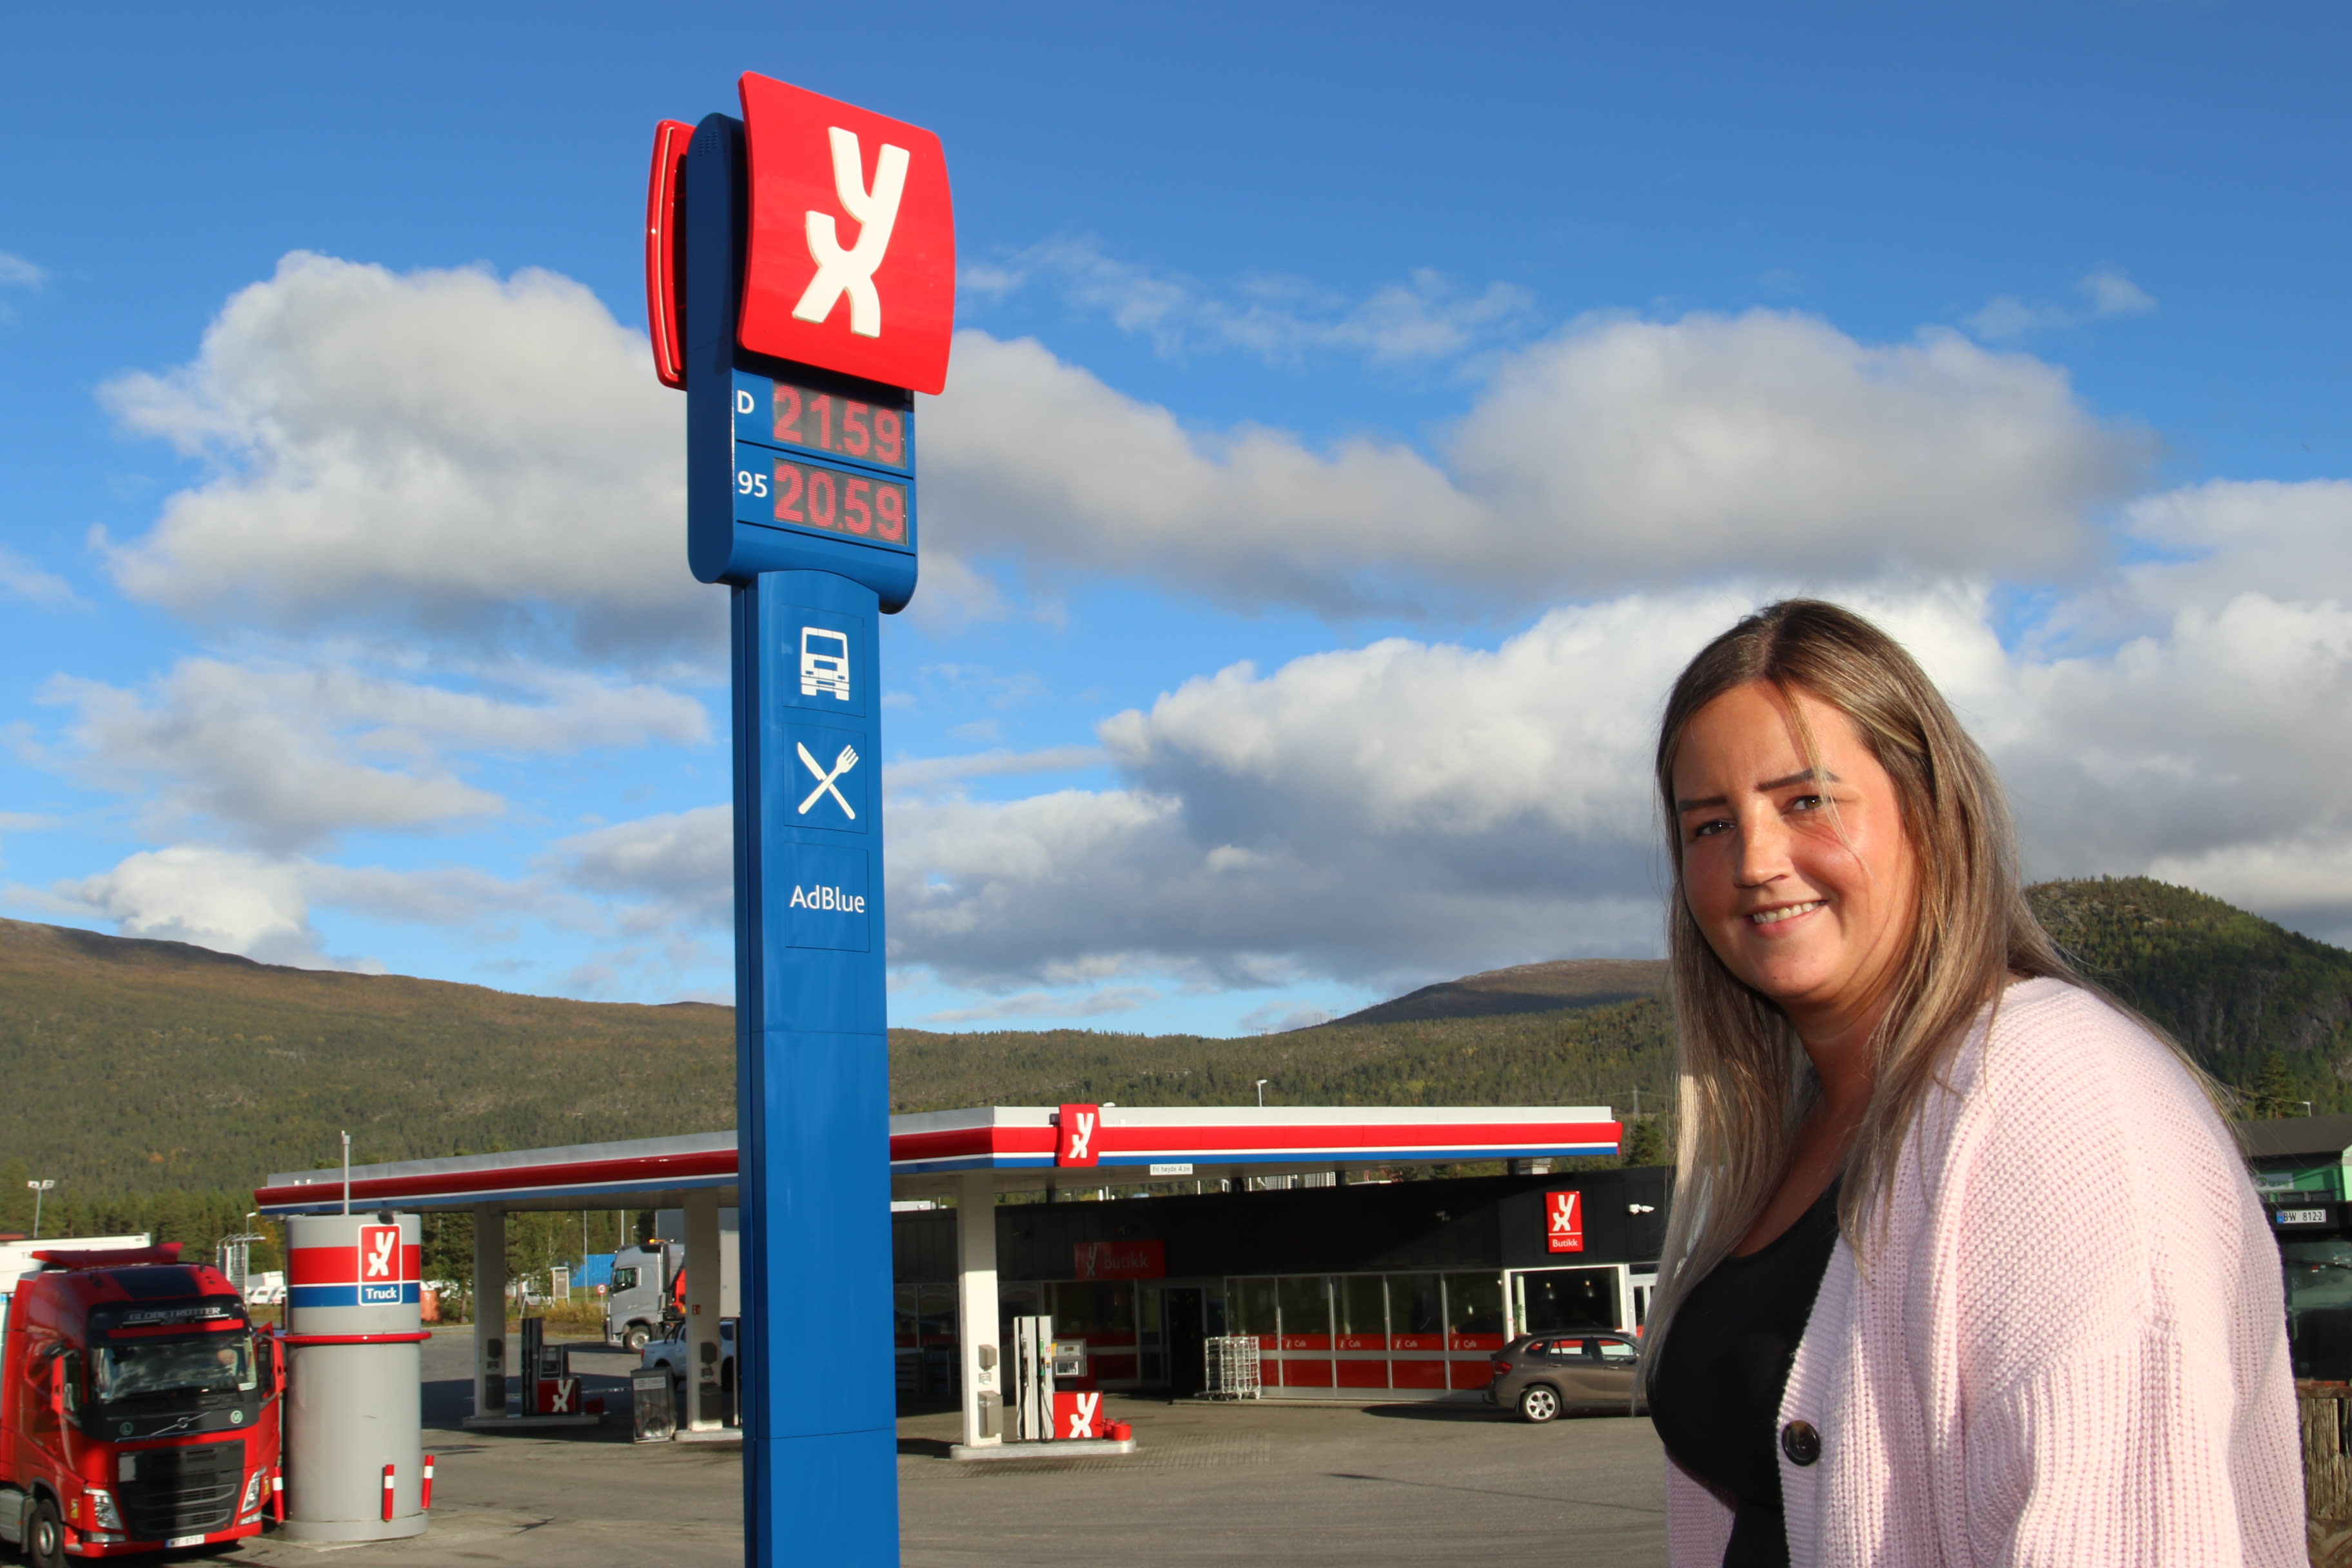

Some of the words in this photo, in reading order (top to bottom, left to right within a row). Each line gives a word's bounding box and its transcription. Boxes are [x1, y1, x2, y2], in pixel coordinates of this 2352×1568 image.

[737, 389, 755, 414] D
[774, 385, 902, 463] 21.59
[738, 471, 768, 498] 95
[774, 464, 903, 541] 20.59
[789, 884, 865, 914] AdBlue
[1553, 1239, 1578, 1248] Butikk
[1103, 1251, 1150, 1269] Butikk
[366, 1287, 397, 1299] Truck
[129, 1307, 221, 1321] GLOBETROTTER
